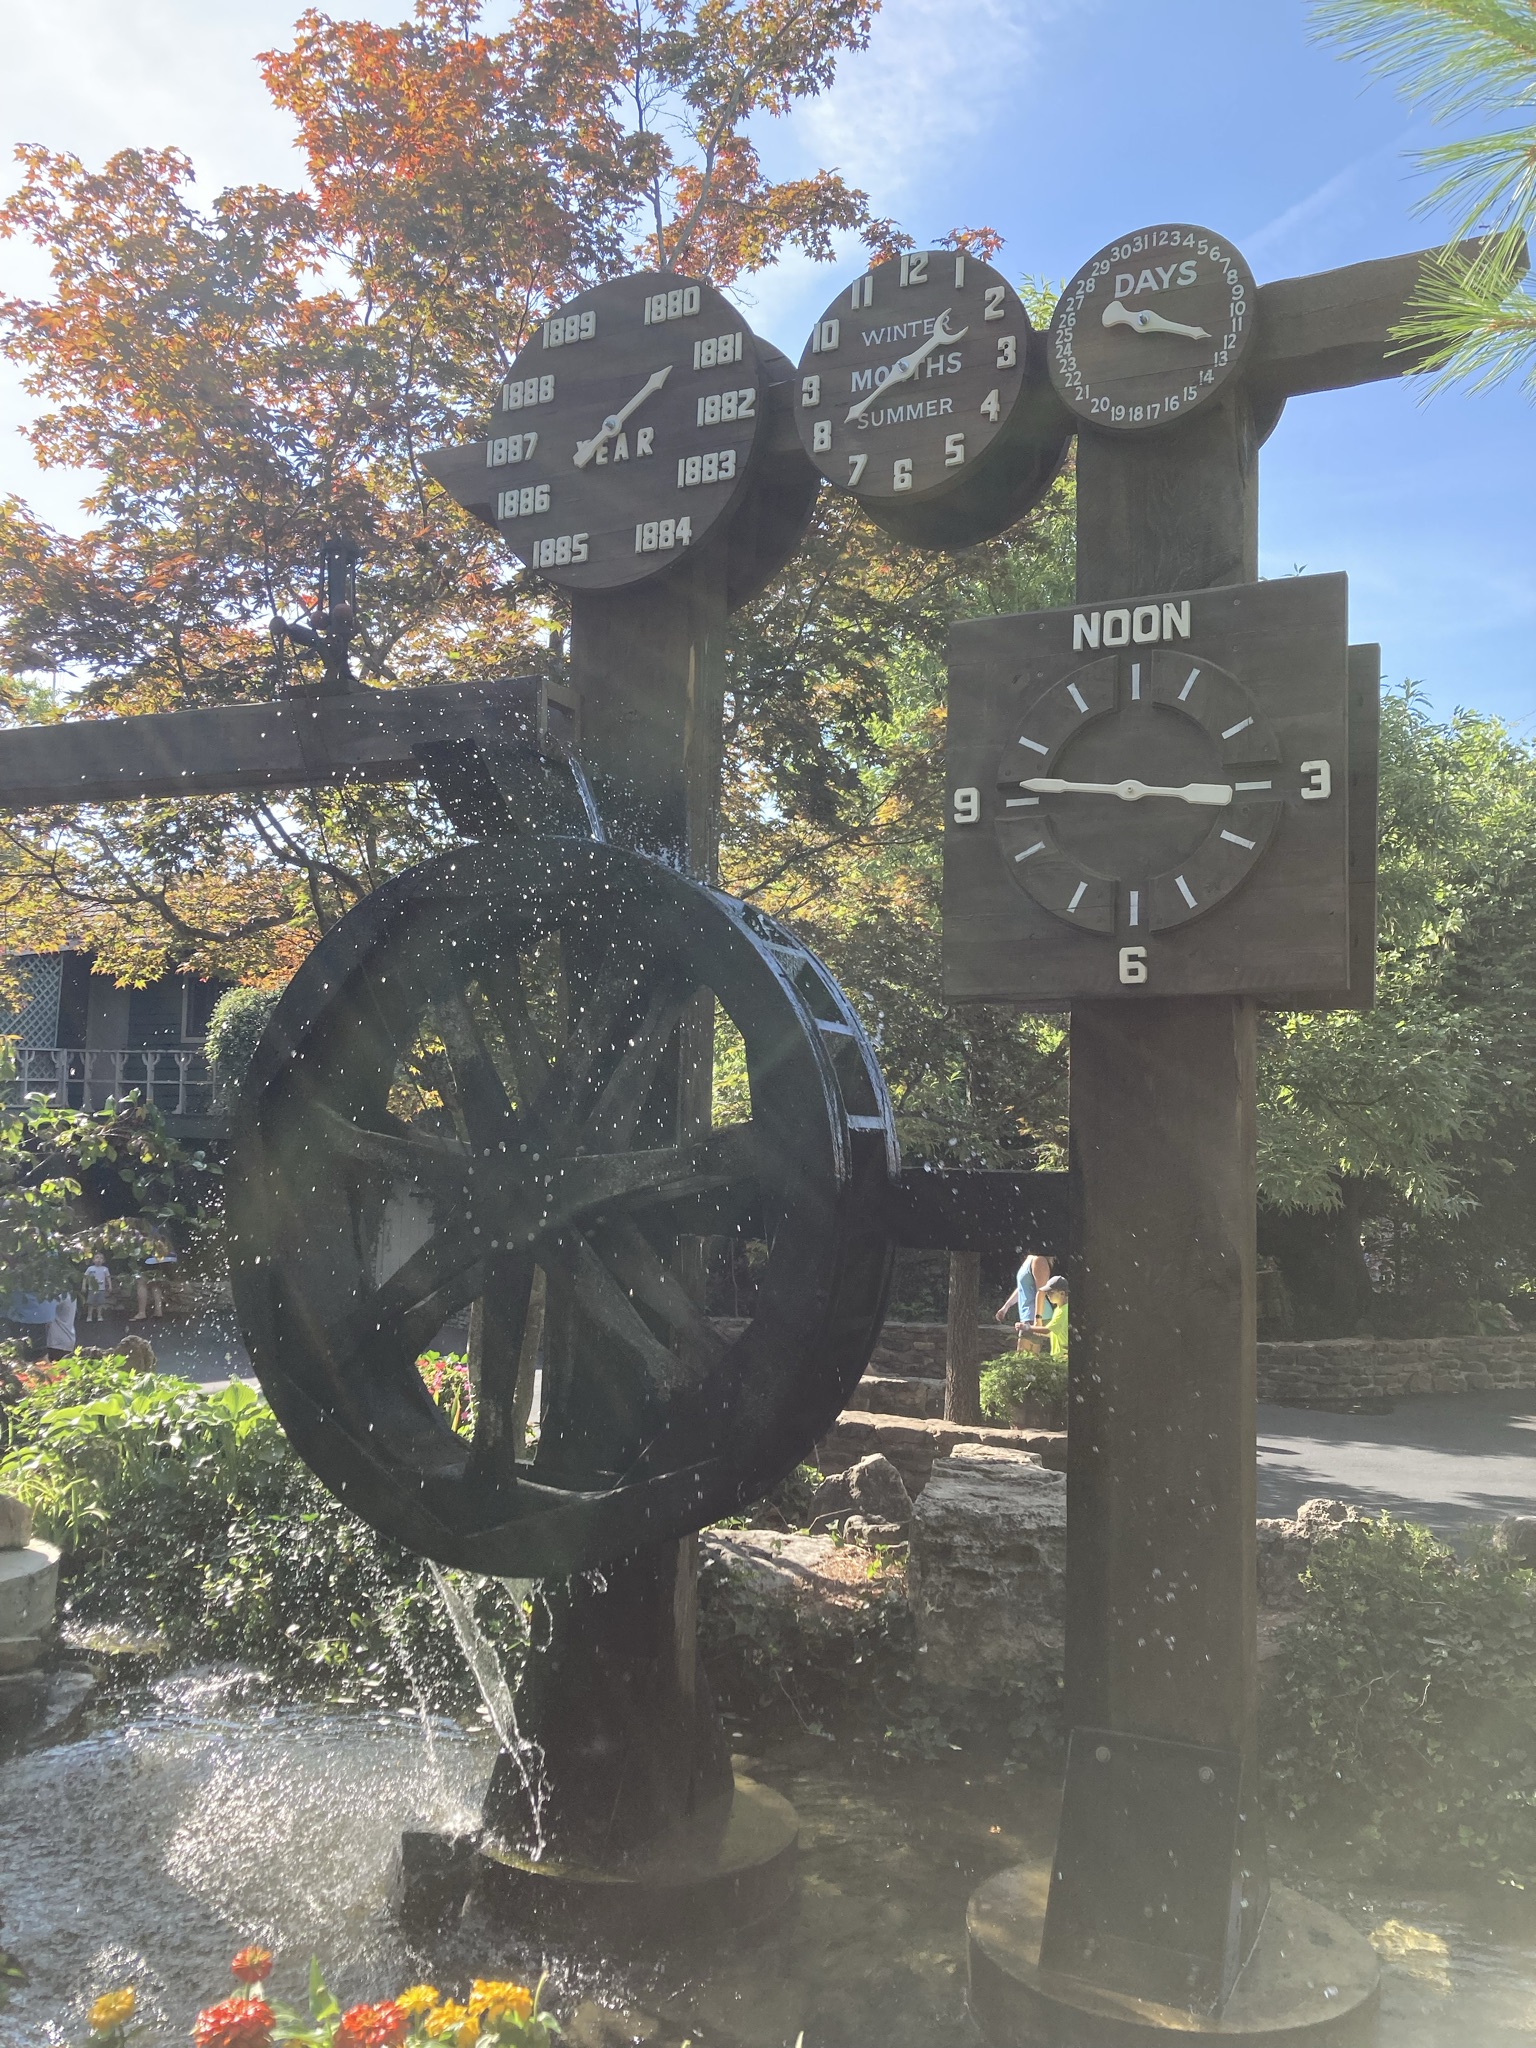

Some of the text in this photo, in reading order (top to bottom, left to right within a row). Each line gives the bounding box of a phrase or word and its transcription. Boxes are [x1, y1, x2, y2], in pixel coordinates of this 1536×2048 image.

[1133, 234, 1149, 252] 31
[1158, 231, 1168, 245] 2
[1170, 231, 1181, 246] 3
[1182, 233, 1195, 247] 4
[1197, 239, 1208, 255] 5
[1110, 244, 1132, 262] 30
[1210, 246, 1220, 261] 6
[900, 251, 928, 287] 12
[955, 256, 964, 288] 1
[1091, 260, 1110, 277] 29
[1219, 258, 1231, 273] 7
[1227, 270, 1238, 284] 8
[1076, 278, 1095, 296] 28
[1114, 260, 1197, 298] DAYS
[851, 275, 873, 310] 11
[984, 286, 1005, 321] 2
[1066, 296, 1084, 312] 27
[1232, 285, 1244, 300] 9
[644, 285, 700, 325] 1880
[1230, 301, 1246, 317] 10
[542, 310, 596, 349] 1889
[861, 316, 952, 346] WINTER
[1058, 313, 1076, 329] 26
[1231, 317, 1242, 332] 11
[812, 319, 840, 353] 10
[1055, 328, 1073, 344] 25
[1223, 334, 1236, 349] 12
[693, 331, 743, 370] 1881
[997, 335, 1016, 369] 3
[1055, 343, 1073, 359] 24
[1214, 351, 1228, 367] 13
[851, 352, 962, 392] MOTHS
[1059, 357, 1077, 374] 23
[1199, 369, 1214, 385] 14
[802, 375, 821, 407] 9
[1065, 371, 1082, 388] 22
[502, 374, 555, 411] 1888
[1075, 385, 1090, 400] 21
[1164, 396, 1179, 411] 16
[1183, 386, 1197, 401] 15
[697, 387, 756, 427] 1882
[857, 398, 953, 430] SUMMER
[980, 389, 1000, 422] 4
[1091, 397, 1110, 413] 20
[1111, 406, 1125, 421] 19
[1129, 407, 1144, 421] 18
[1146, 404, 1160, 419] 17
[813, 420, 832, 453] 8
[486, 432, 538, 468] 1887
[945, 433, 965, 467] 5
[677, 449, 736, 488] 1883
[848, 454, 868, 486] 7
[893, 458, 913, 491] 6
[498, 484, 550, 520] 1886
[635, 516, 692, 553] 1884
[532, 533, 589, 569] 1885
[1072, 600, 1191, 650] NOON
[1300, 759, 1331, 799] 3
[953, 786, 980, 824] 9
[1118, 945, 1148, 984] 6
